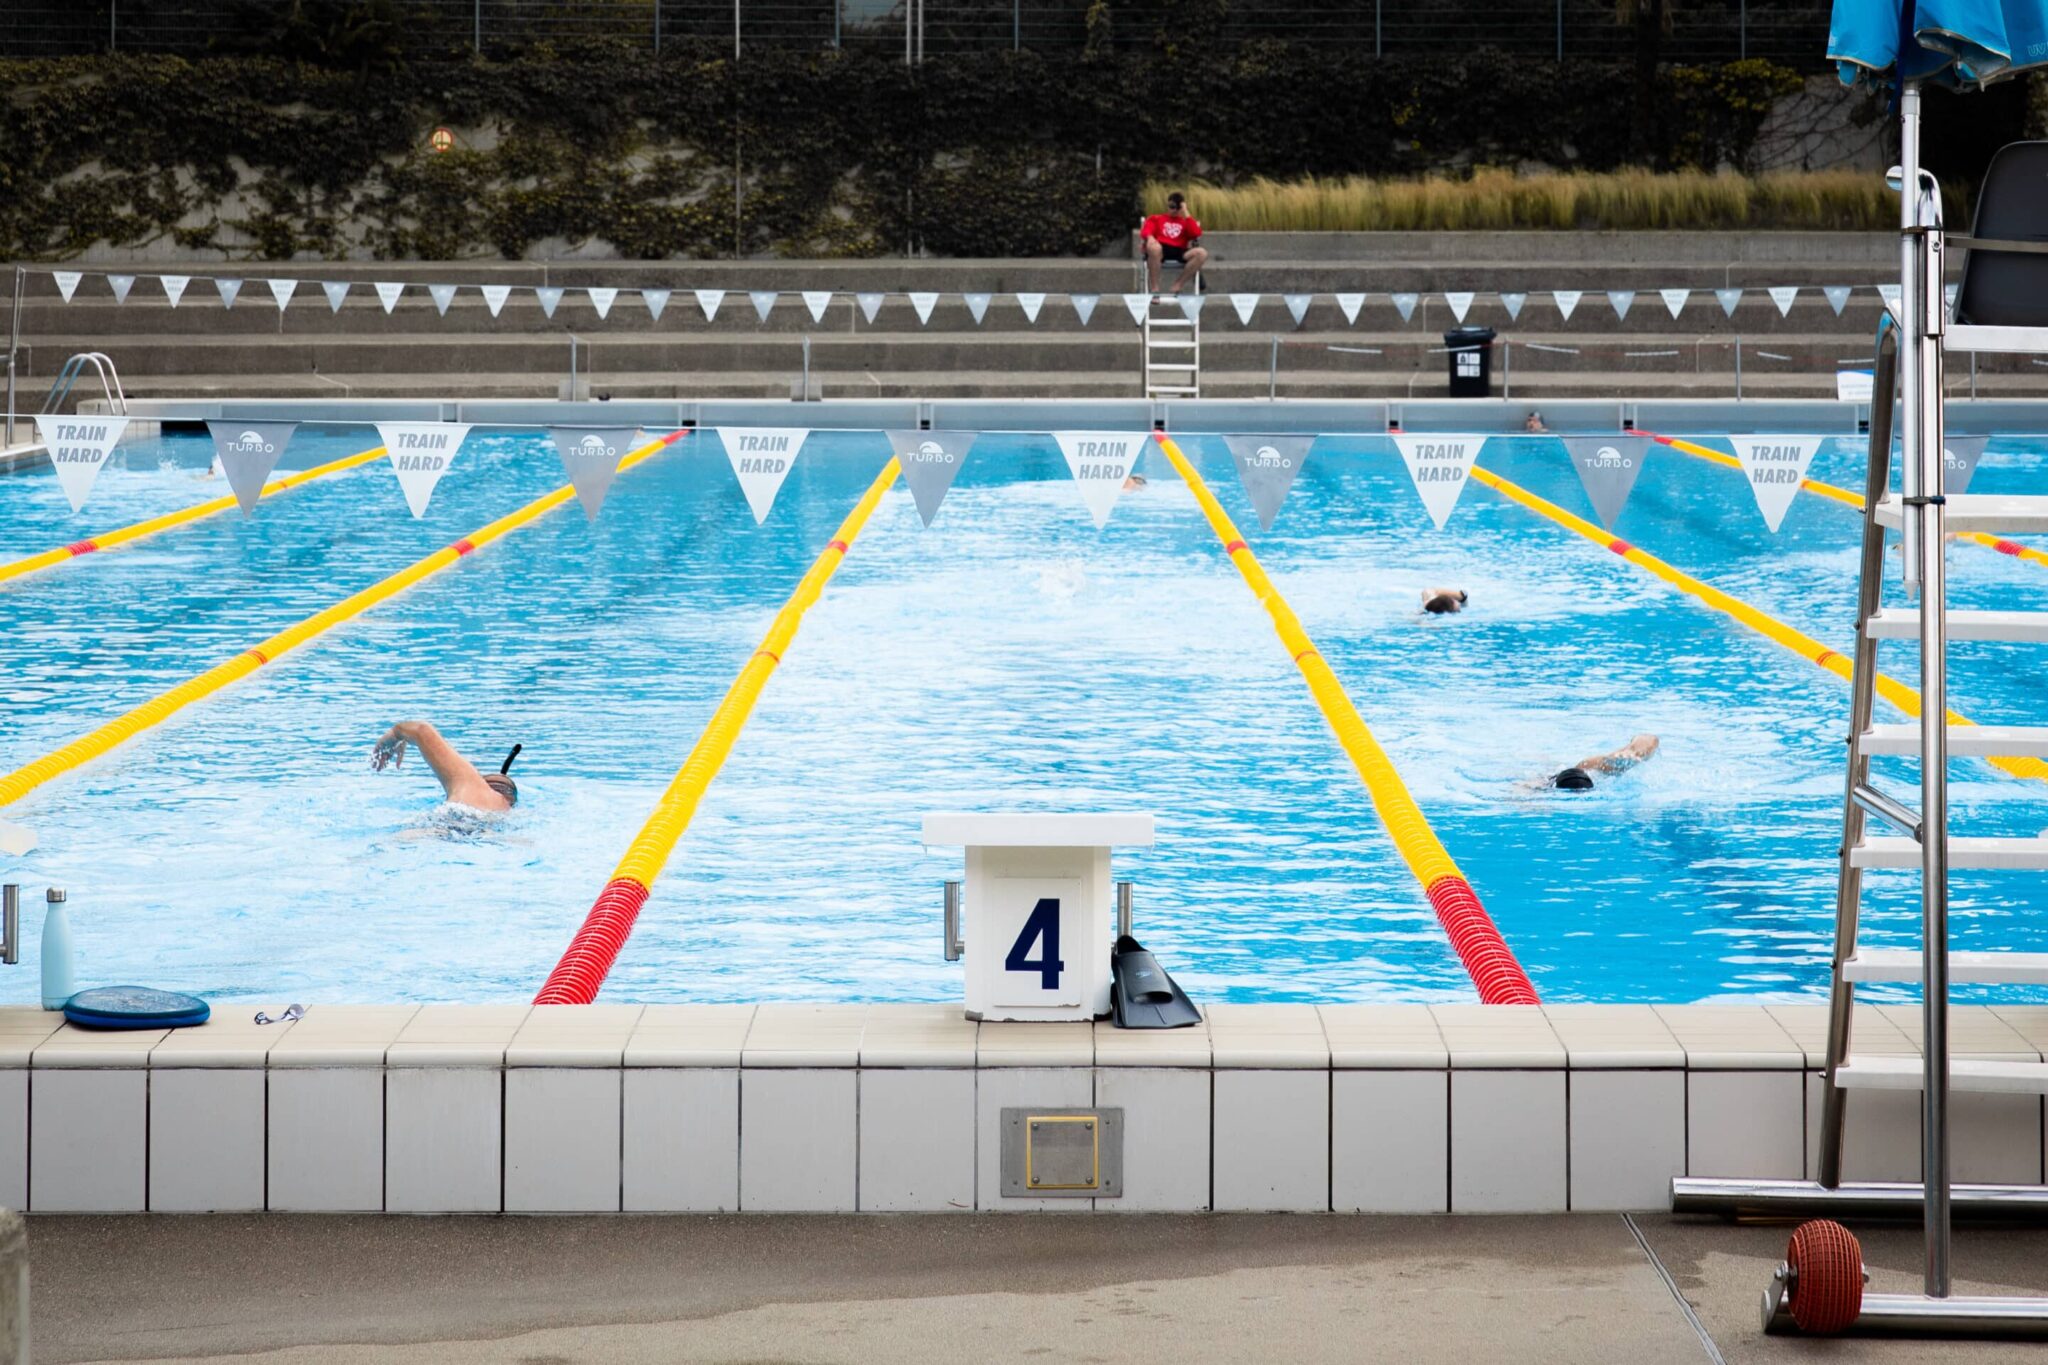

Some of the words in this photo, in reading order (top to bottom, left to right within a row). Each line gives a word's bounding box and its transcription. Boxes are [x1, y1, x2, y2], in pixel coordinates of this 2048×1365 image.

[56, 425, 108, 442] TRAIN
[398, 433, 448, 450] TRAIN
[227, 442, 274, 452] TURBO
[569, 446, 616, 457] TURBO
[739, 436, 788, 452] TRAIN
[1077, 442, 1127, 457] TRAIN
[1415, 444, 1465, 460] TRAIN
[56, 447, 103, 463] HARD
[907, 453, 954, 463] TURBO
[1751, 446, 1801, 462] TRAIN
[398, 455, 445, 471] HARD
[739, 458, 786, 474] HARD
[1244, 457, 1292, 468] TURBO
[1584, 458, 1632, 468] TURBO
[1078, 465, 1125, 480] HARD
[1417, 467, 1463, 482] HARD
[1753, 468, 1798, 484] HARD
[1005, 898, 1064, 990] 4
